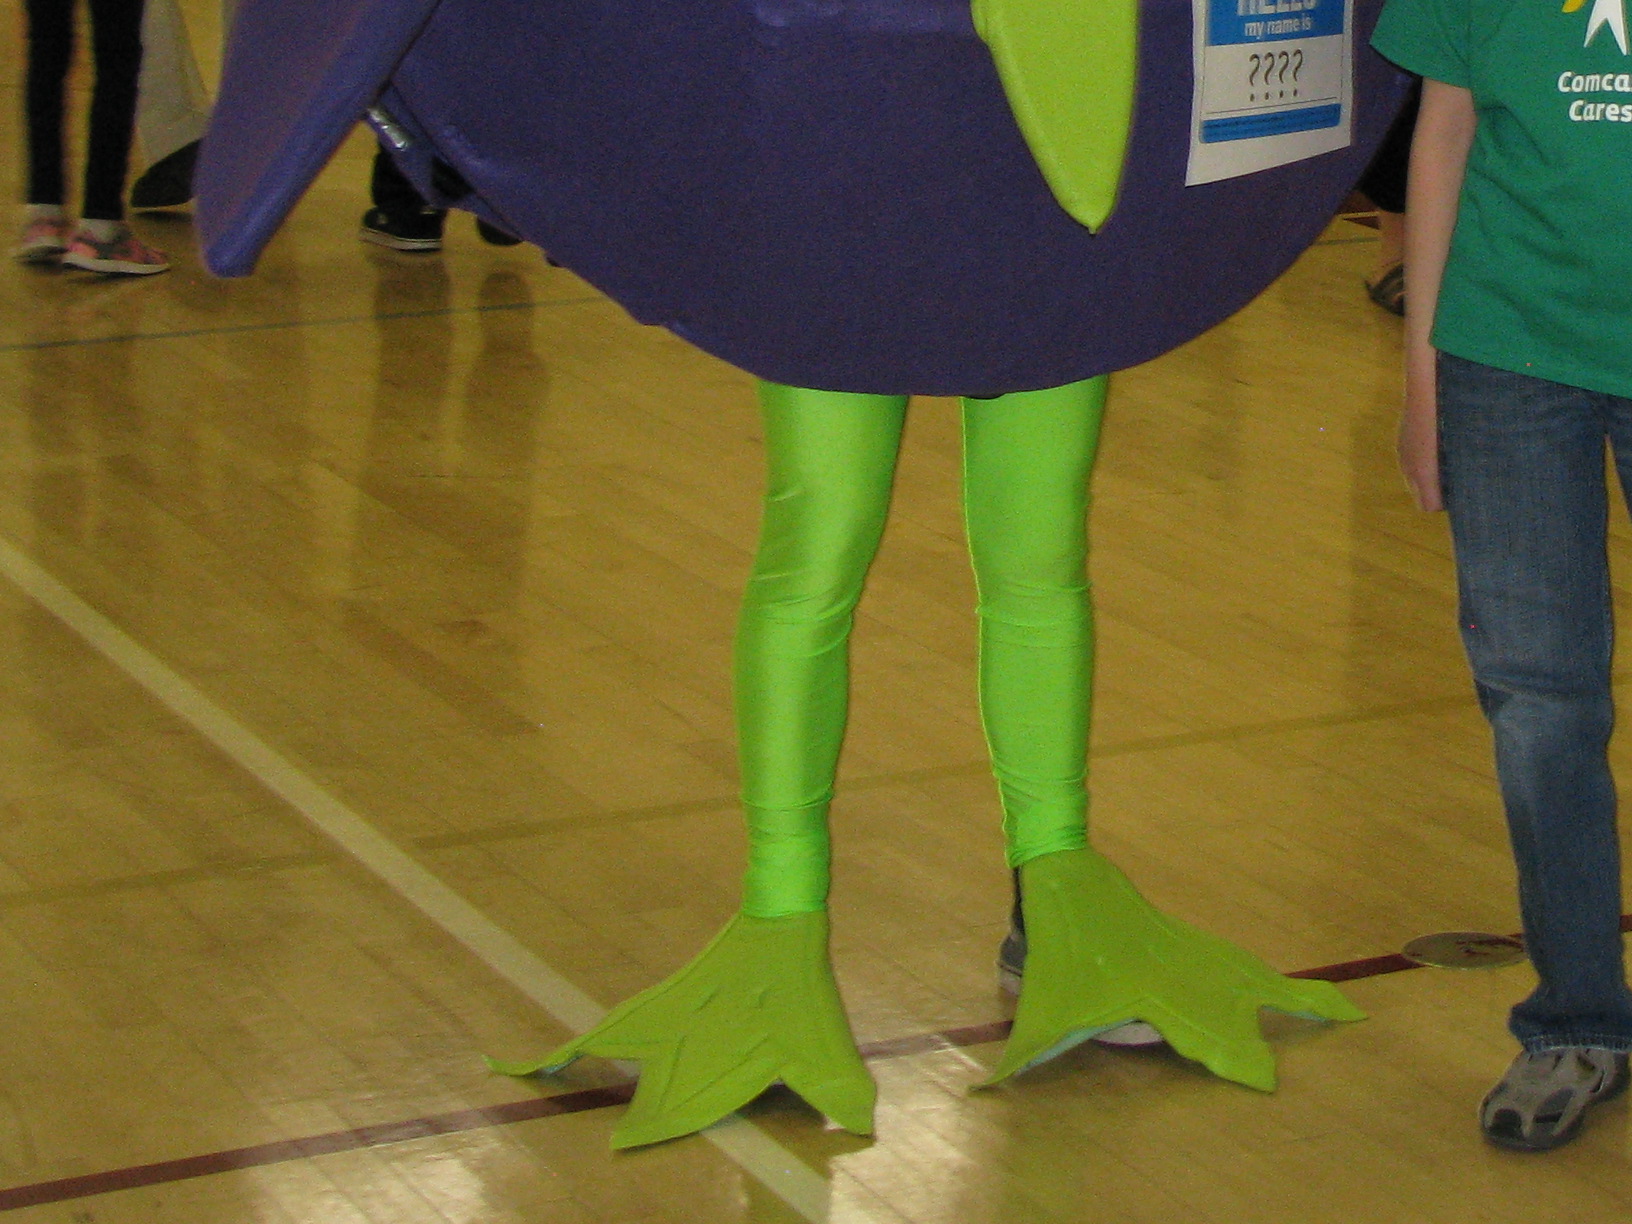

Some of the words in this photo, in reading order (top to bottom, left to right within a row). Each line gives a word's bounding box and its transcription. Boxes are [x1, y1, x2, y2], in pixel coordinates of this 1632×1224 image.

[1244, 22, 1264, 39] my
[1267, 18, 1299, 36] name
[1302, 15, 1313, 32] is
